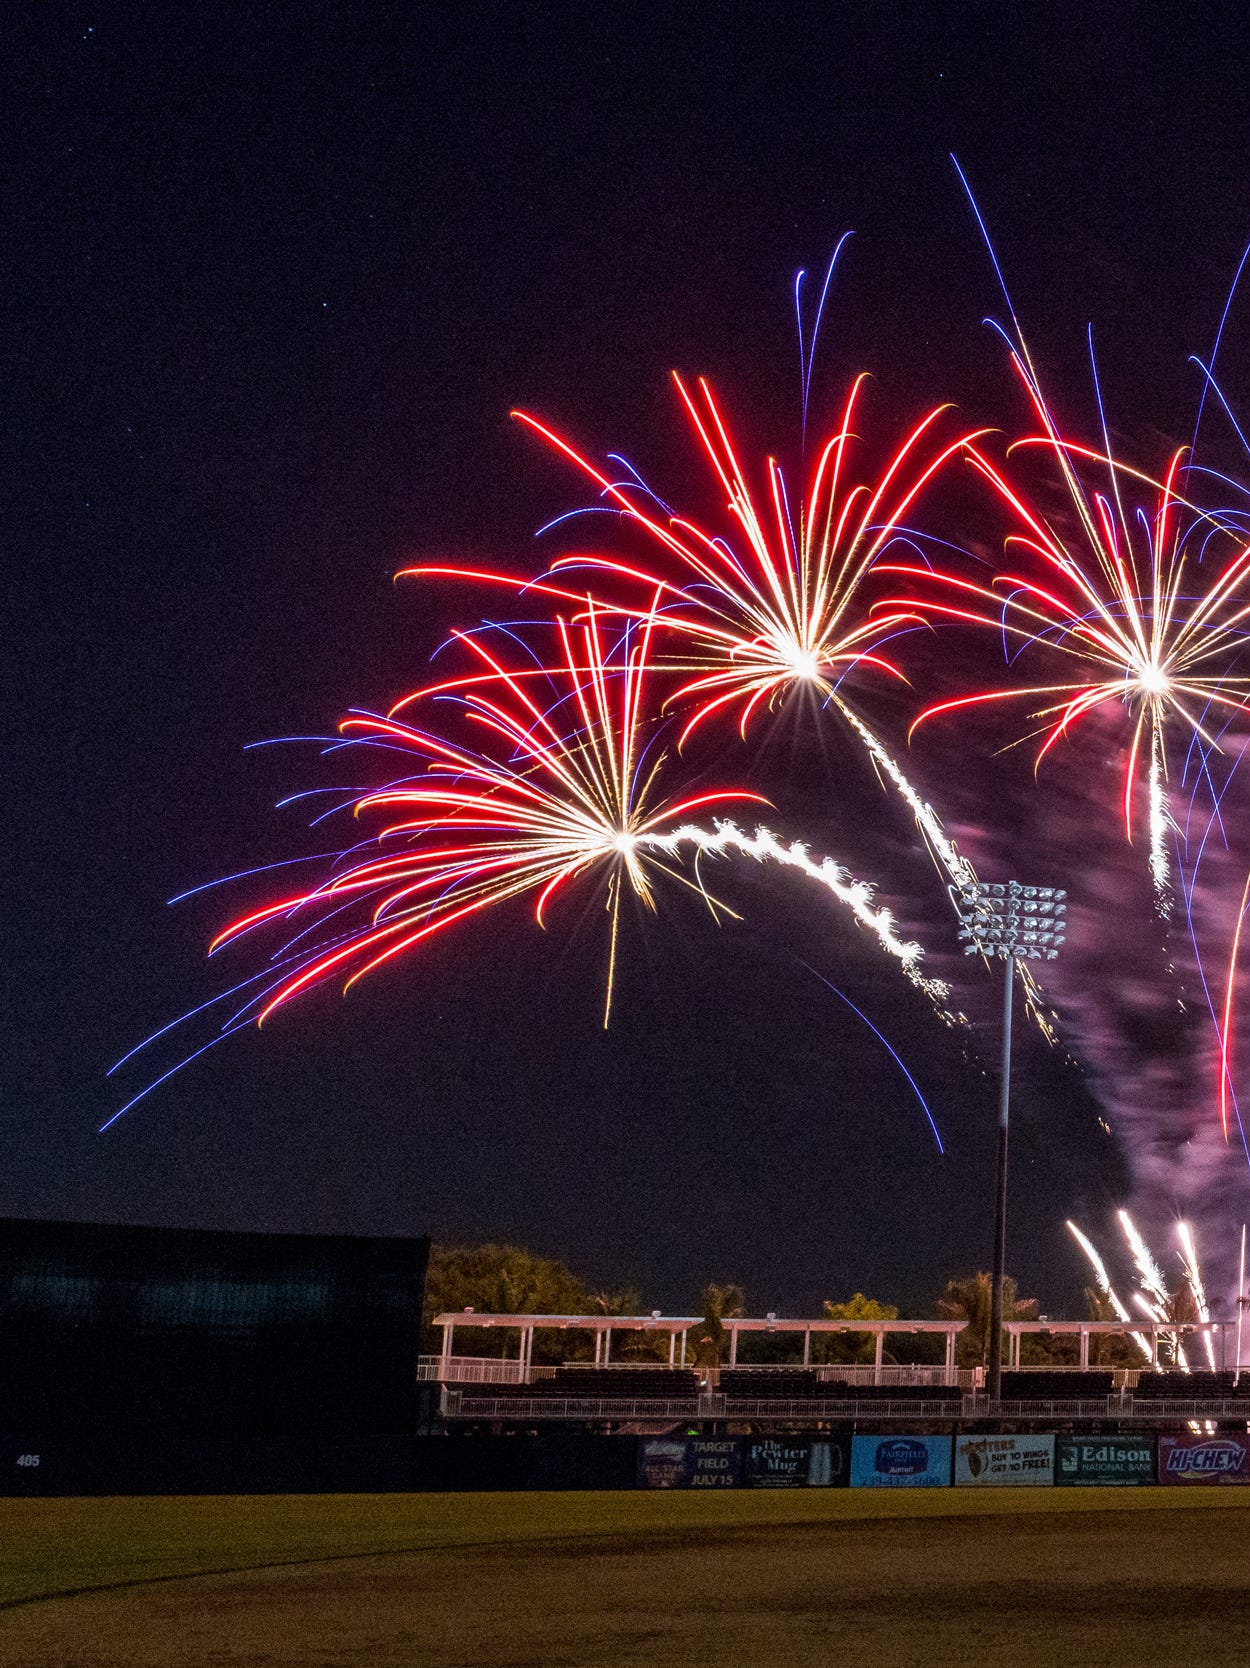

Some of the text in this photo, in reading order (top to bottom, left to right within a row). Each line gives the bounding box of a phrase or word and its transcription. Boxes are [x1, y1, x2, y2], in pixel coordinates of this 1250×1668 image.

[692, 1441, 736, 1452] TARGET
[763, 1439, 783, 1449] The
[960, 1440, 1015, 1455] HOOTERS
[751, 1445, 808, 1459] Pewter
[991, 1450, 1049, 1462] BUY 10 WINGS
[1082, 1446, 1151, 1462] Edison
[17, 1455, 40, 1467] 405
[697, 1458, 729, 1469] FIELD
[991, 1458, 1050, 1473] GET 10 FREE!
[1167, 1448, 1247, 1471] HI-CHEW
[767, 1459, 798, 1474] Mug
[1082, 1463, 1151, 1472] NATIONAL BANK
[691, 1474, 733, 1486] JULY 15
